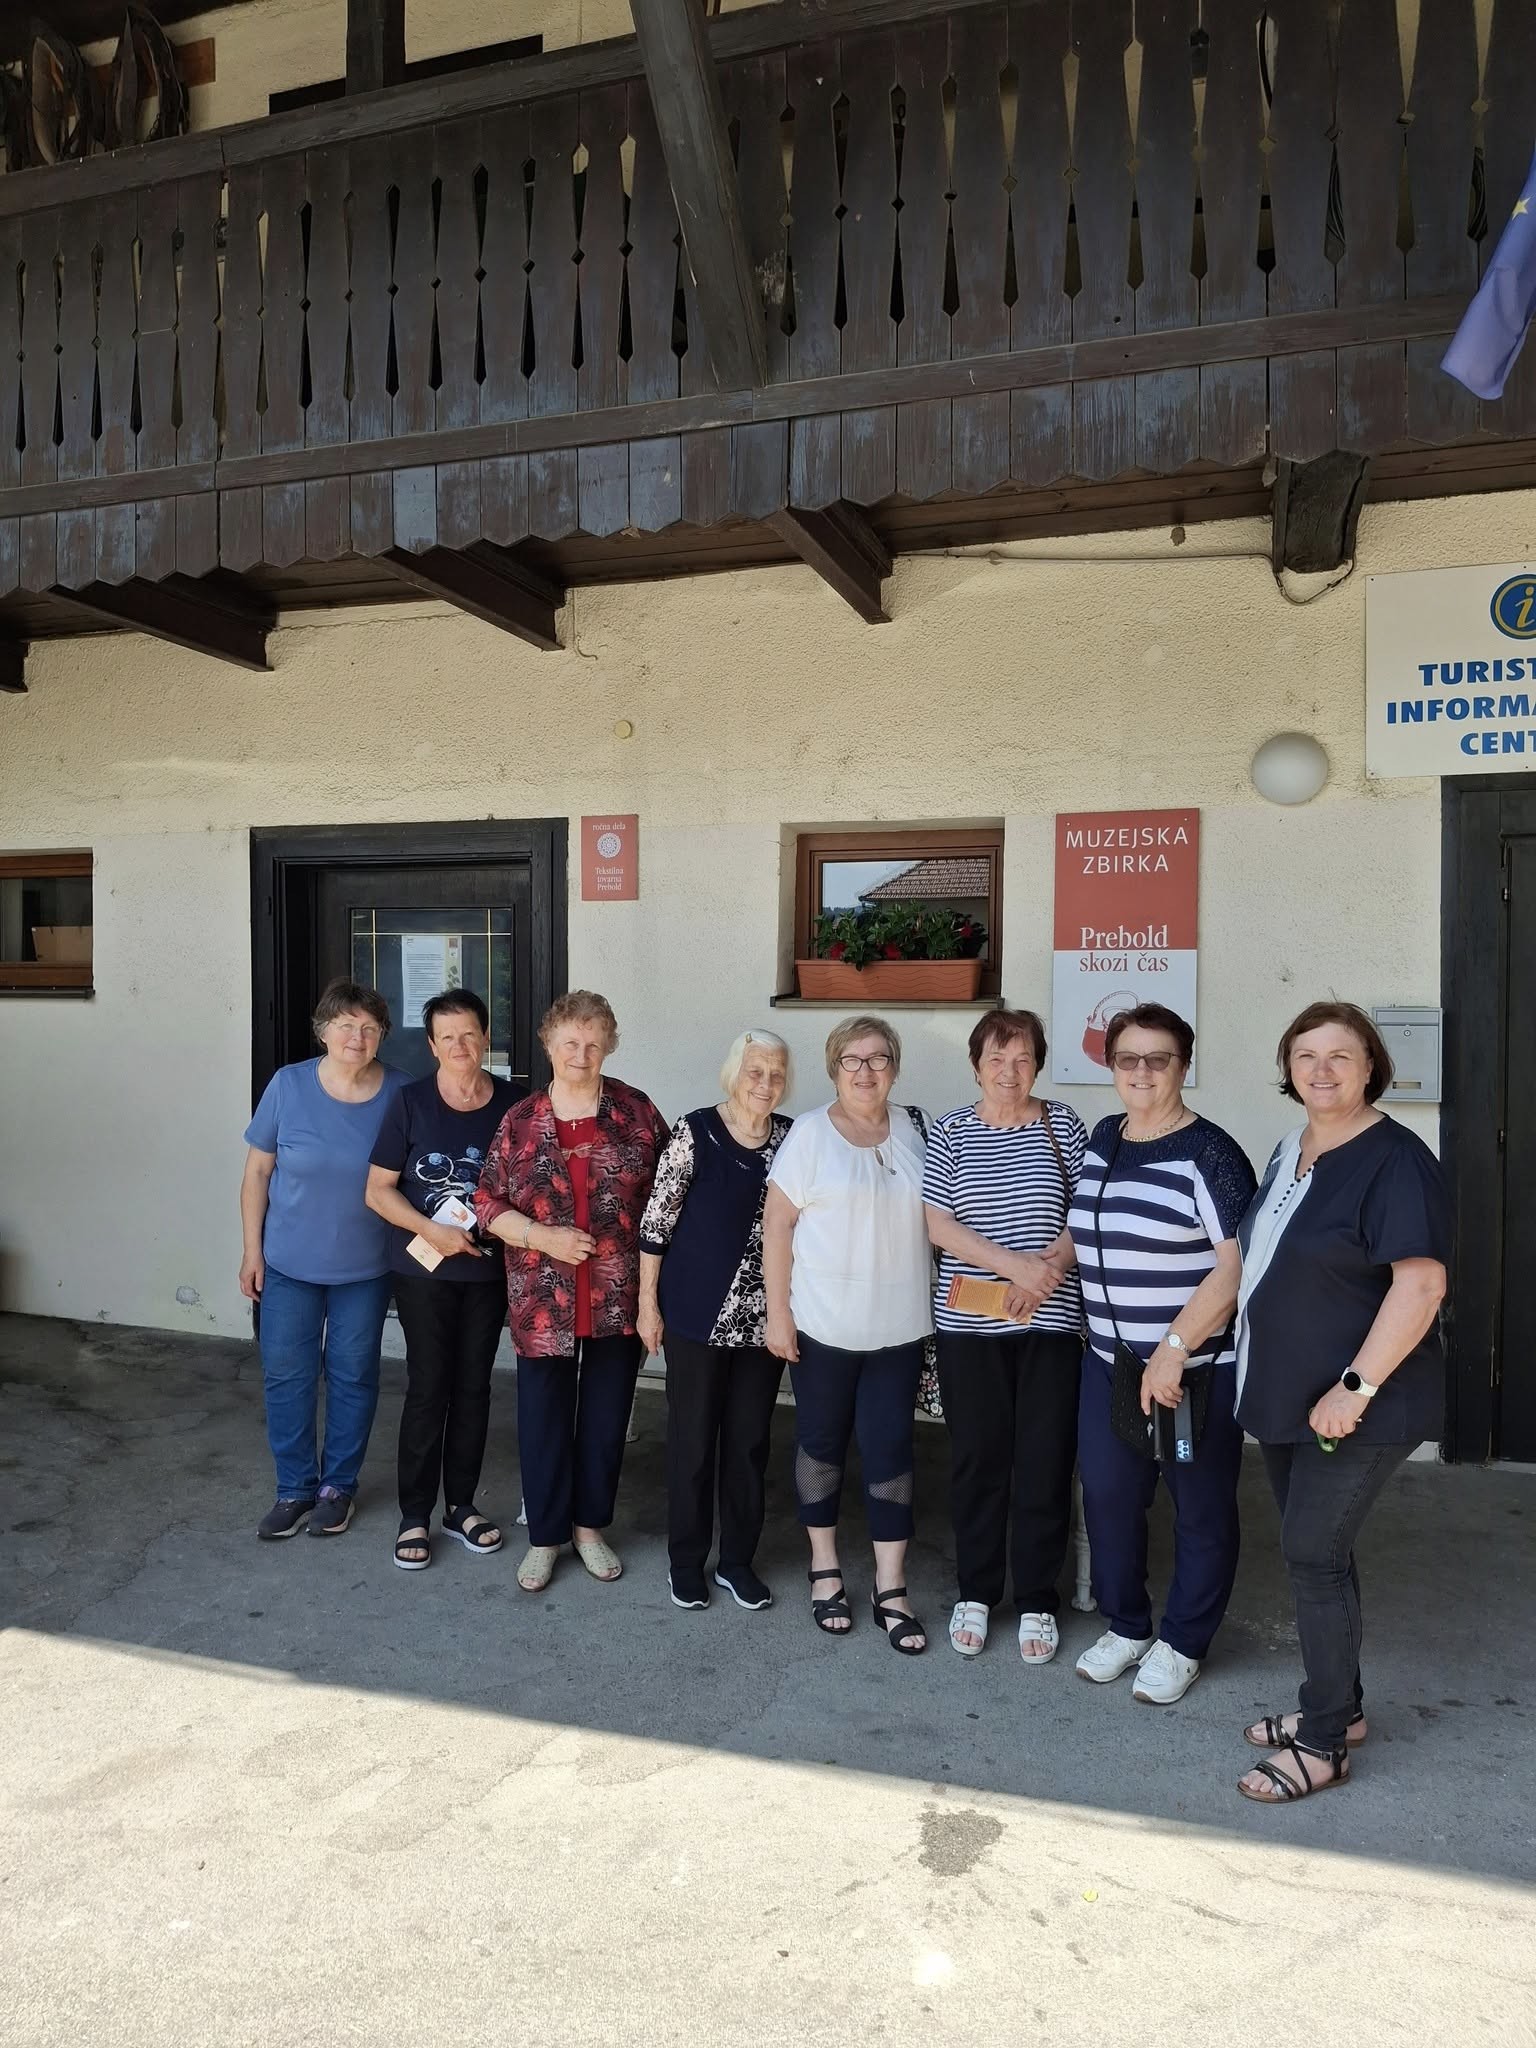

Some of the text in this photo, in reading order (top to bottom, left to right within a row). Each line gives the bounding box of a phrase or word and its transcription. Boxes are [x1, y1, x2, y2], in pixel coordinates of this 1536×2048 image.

[1387, 694, 1536, 724] INFORM
[1066, 826, 1188, 849] MUZEJSKA
[1082, 854, 1169, 874] ZBIRKA
[597, 883, 622, 891] Prebold
[1080, 925, 1168, 949] Prebold
[1079, 952, 1168, 972] skozi čas
